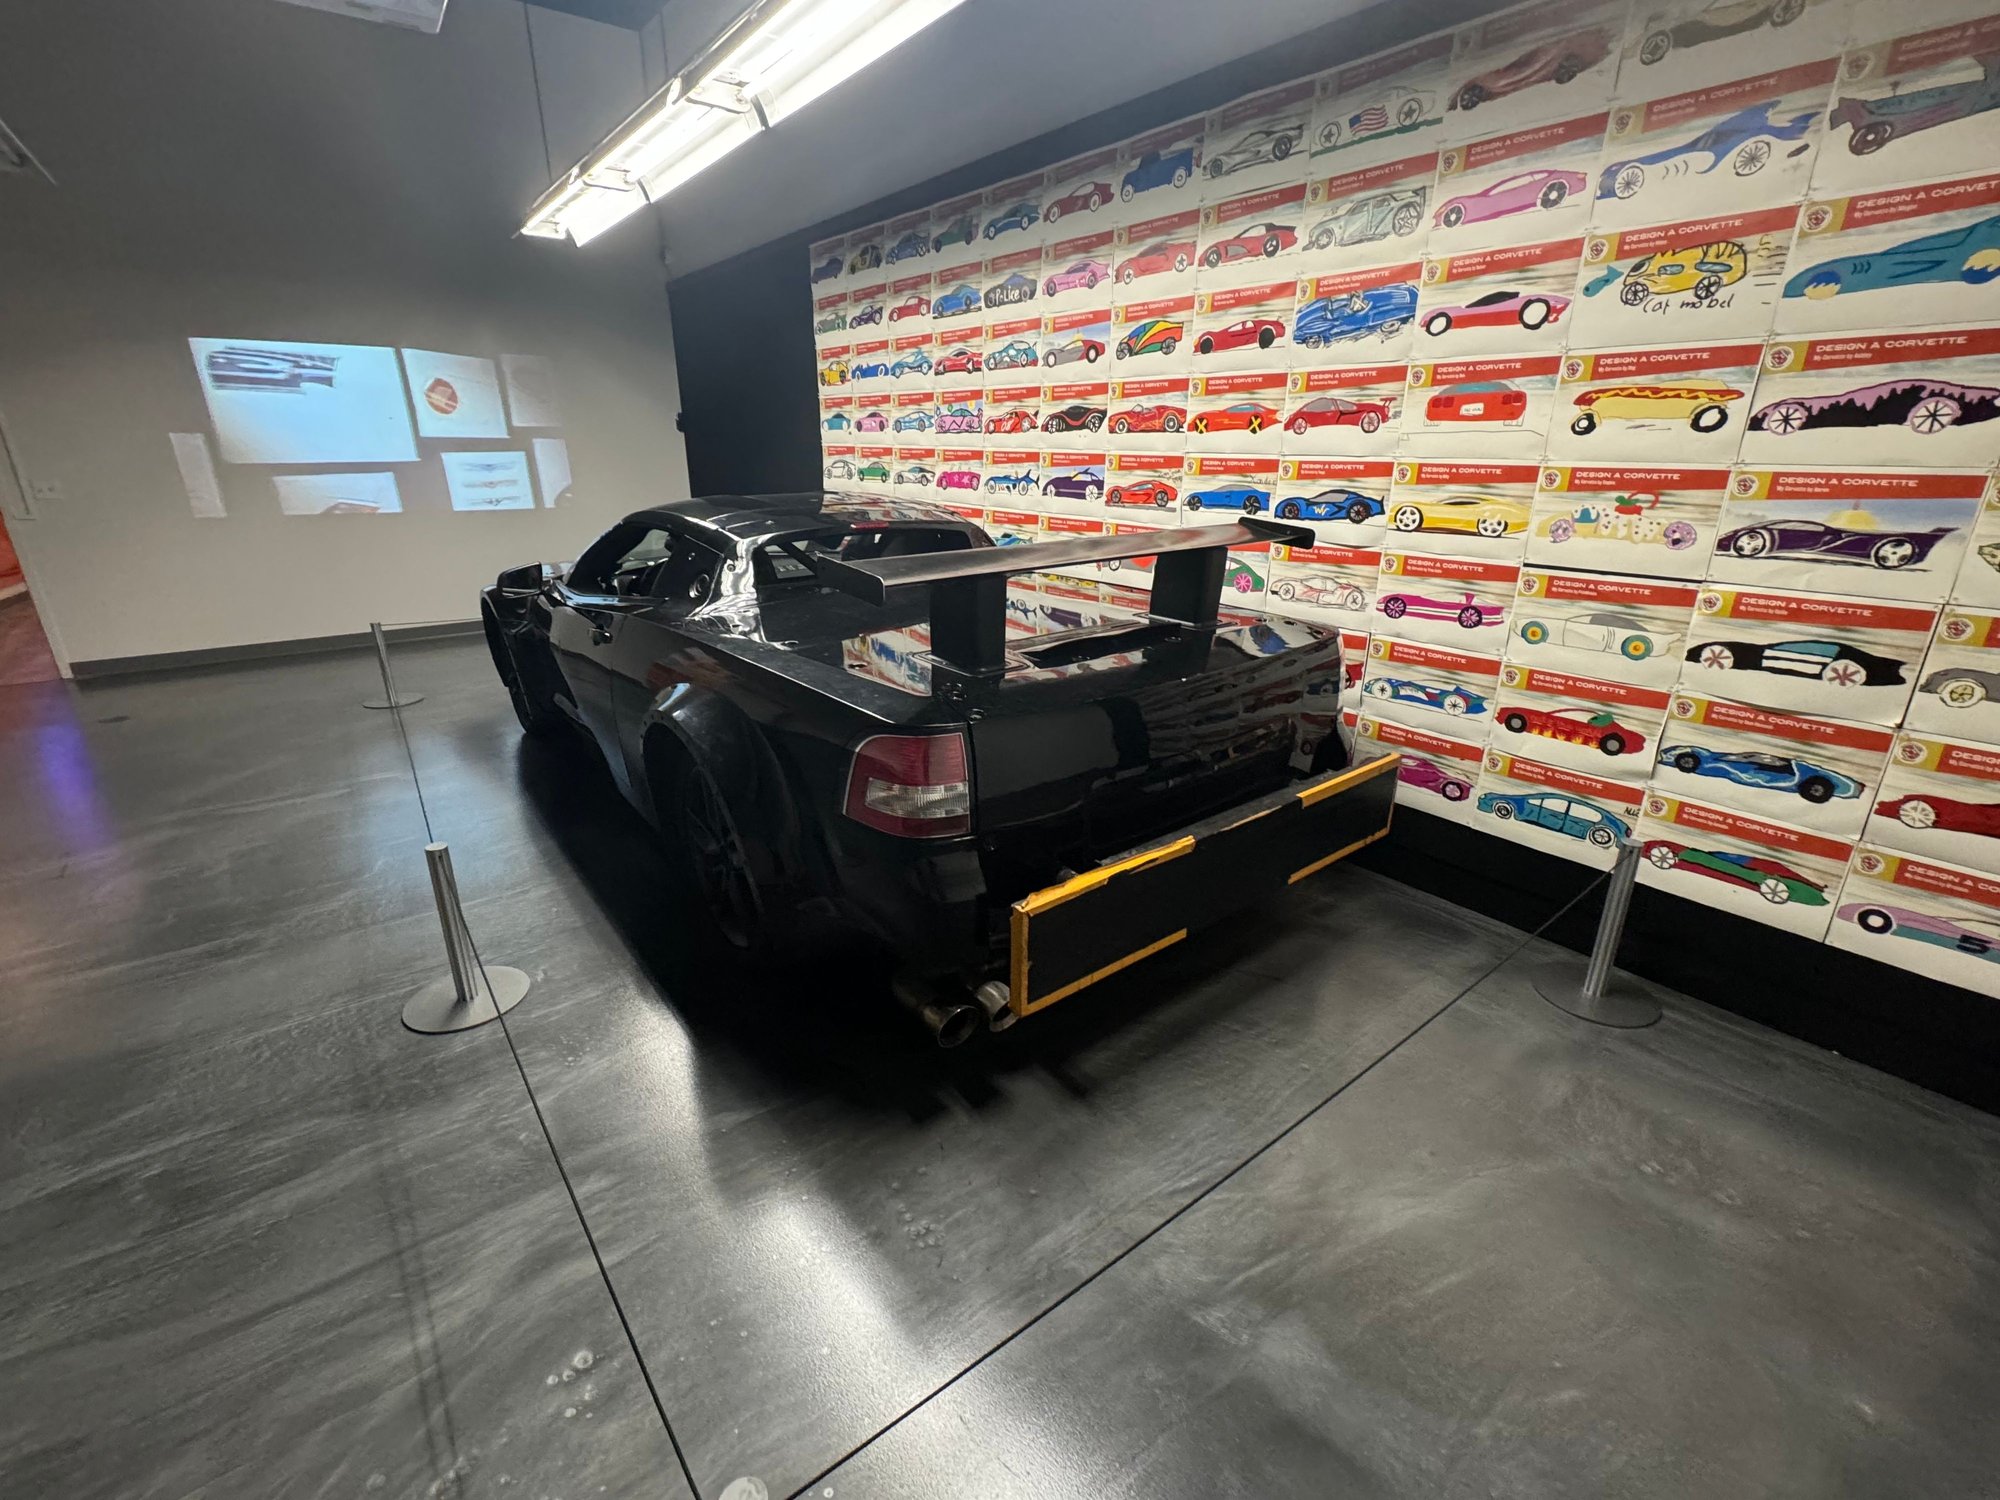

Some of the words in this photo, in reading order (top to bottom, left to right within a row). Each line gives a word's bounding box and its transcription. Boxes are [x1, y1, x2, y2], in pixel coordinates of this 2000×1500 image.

[1709, 78, 1778, 99] CORVETTE
[1512, 127, 1565, 144] CORVETTE
[1365, 164, 1404, 178] CORVETTE
[1857, 194, 1912, 209] DESIGN
[1915, 191, 1926, 199] A
[1625, 231, 1665, 242] DESIGN
[1677, 219, 1743, 234] CORVETTE
[1453, 256, 1484, 267] DESIGN
[1492, 247, 1542, 261] CORVETTE
[1350, 269, 1390, 282] CORVETTE
[1815, 342, 1867, 352] DESIGN
[1884, 335, 1967, 349] CORVETTE
[1599, 356, 1638, 365] DESIGN
[1649, 351, 1710, 362] CORVETTE
[1340, 370, 1377, 378] CORVETTE
[1437, 365, 1466, 373] DESIGN
[1475, 362, 1521, 371] CORVETTE
[1622, 472, 1681, 480] CORVETTE
[1778, 476, 1826, 484] DESIGN
[1841, 478, 1918, 487] CORVETTE
[1319, 549, 1353, 557] CORVETTE
[1442, 562, 1484, 572] CORVETTE
[1552, 579, 1587, 588] DESIGN
[1596, 584, 1651, 595] CORVETTE
[1741, 596, 1787, 607] DESIGN
[1800, 603, 1873, 617] CORVETTE
[1394, 645, 1419, 654] DESIGN
[1426, 651, 1466, 664] CORVETTE
[1533, 673, 1565, 684] DESIGN
[1575, 680, 1627, 695] CORVETTE
[1712, 705, 1755, 719] DESIGN
[1767, 716, 1835, 734] CORVETTE
[1413, 734, 1451, 749] CORVETTE
[1514, 762, 1545, 774] DESIGN
[1553, 772, 1603, 789] CORVETTE
[1683, 806, 1724, 821] DESIGN
[1735, 820, 1799, 841] CORVETTE
[1907, 864, 1960, 883] DESIGN
[1963, 879, 1974, 887] A
[1978, 882, 2000, 893] CO
